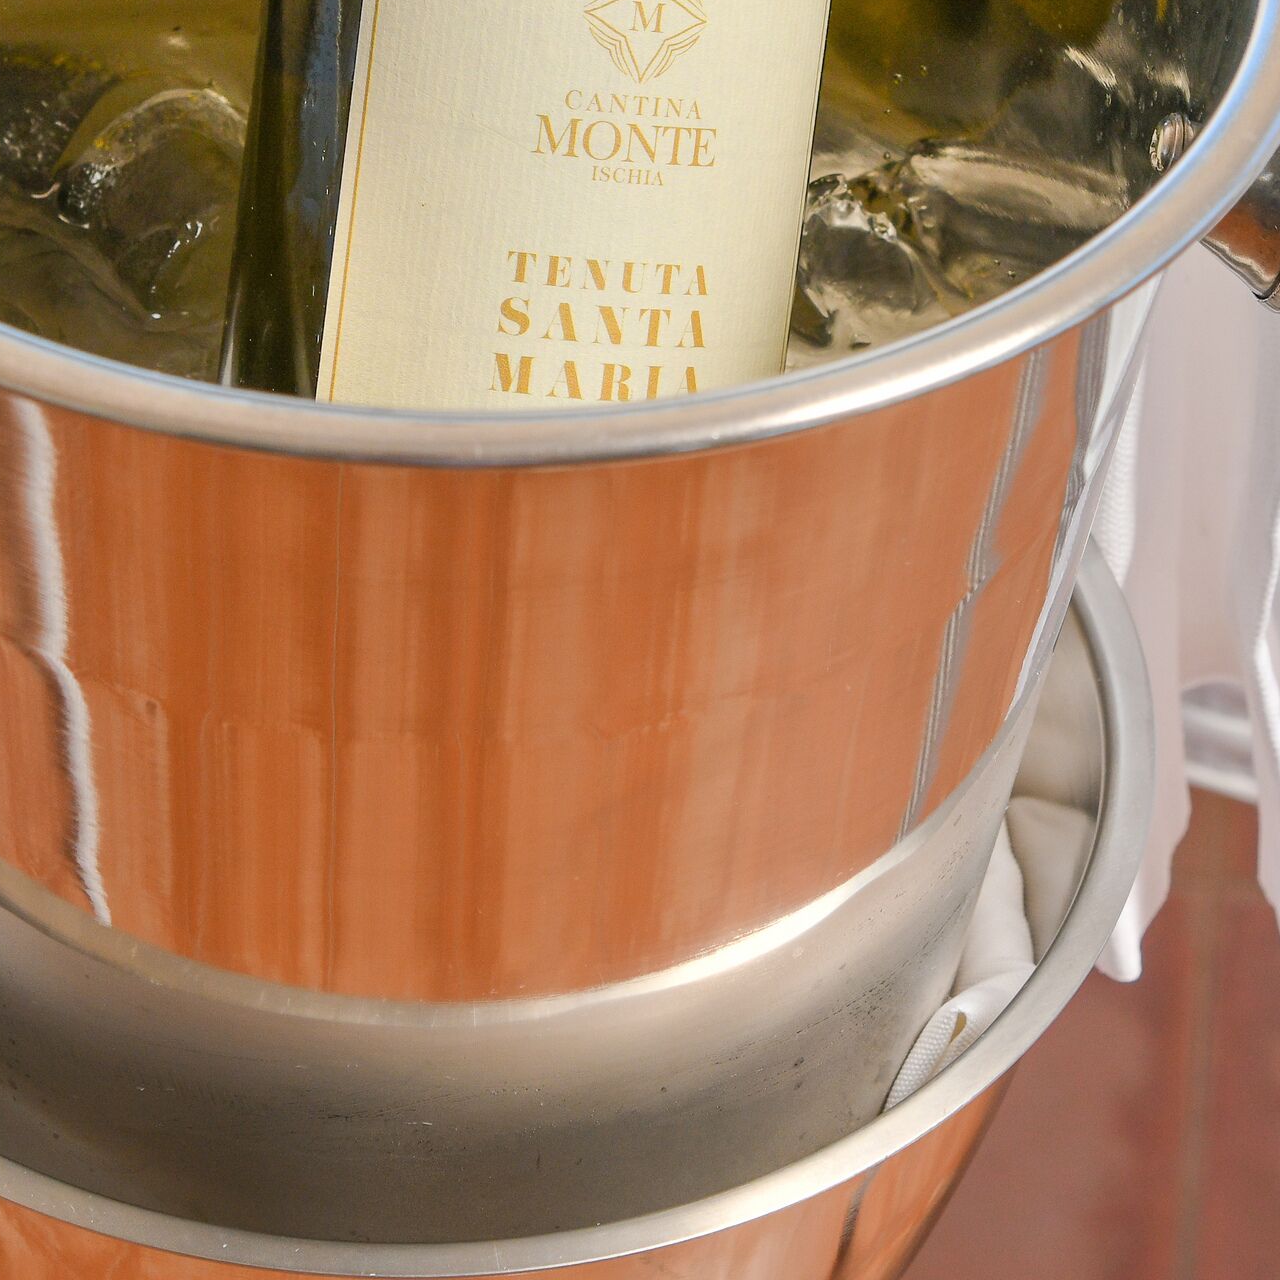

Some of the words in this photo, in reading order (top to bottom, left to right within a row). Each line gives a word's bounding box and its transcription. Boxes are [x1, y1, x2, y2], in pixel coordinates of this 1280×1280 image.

[629, 1, 665, 34] M
[564, 89, 702, 120] CANTINA
[530, 114, 717, 167] MONTE
[591, 165, 664, 186] ISCHIA
[507, 250, 708, 296] TENUTA
[497, 296, 706, 348] SANTA
[488, 352, 699, 401] MARIA
